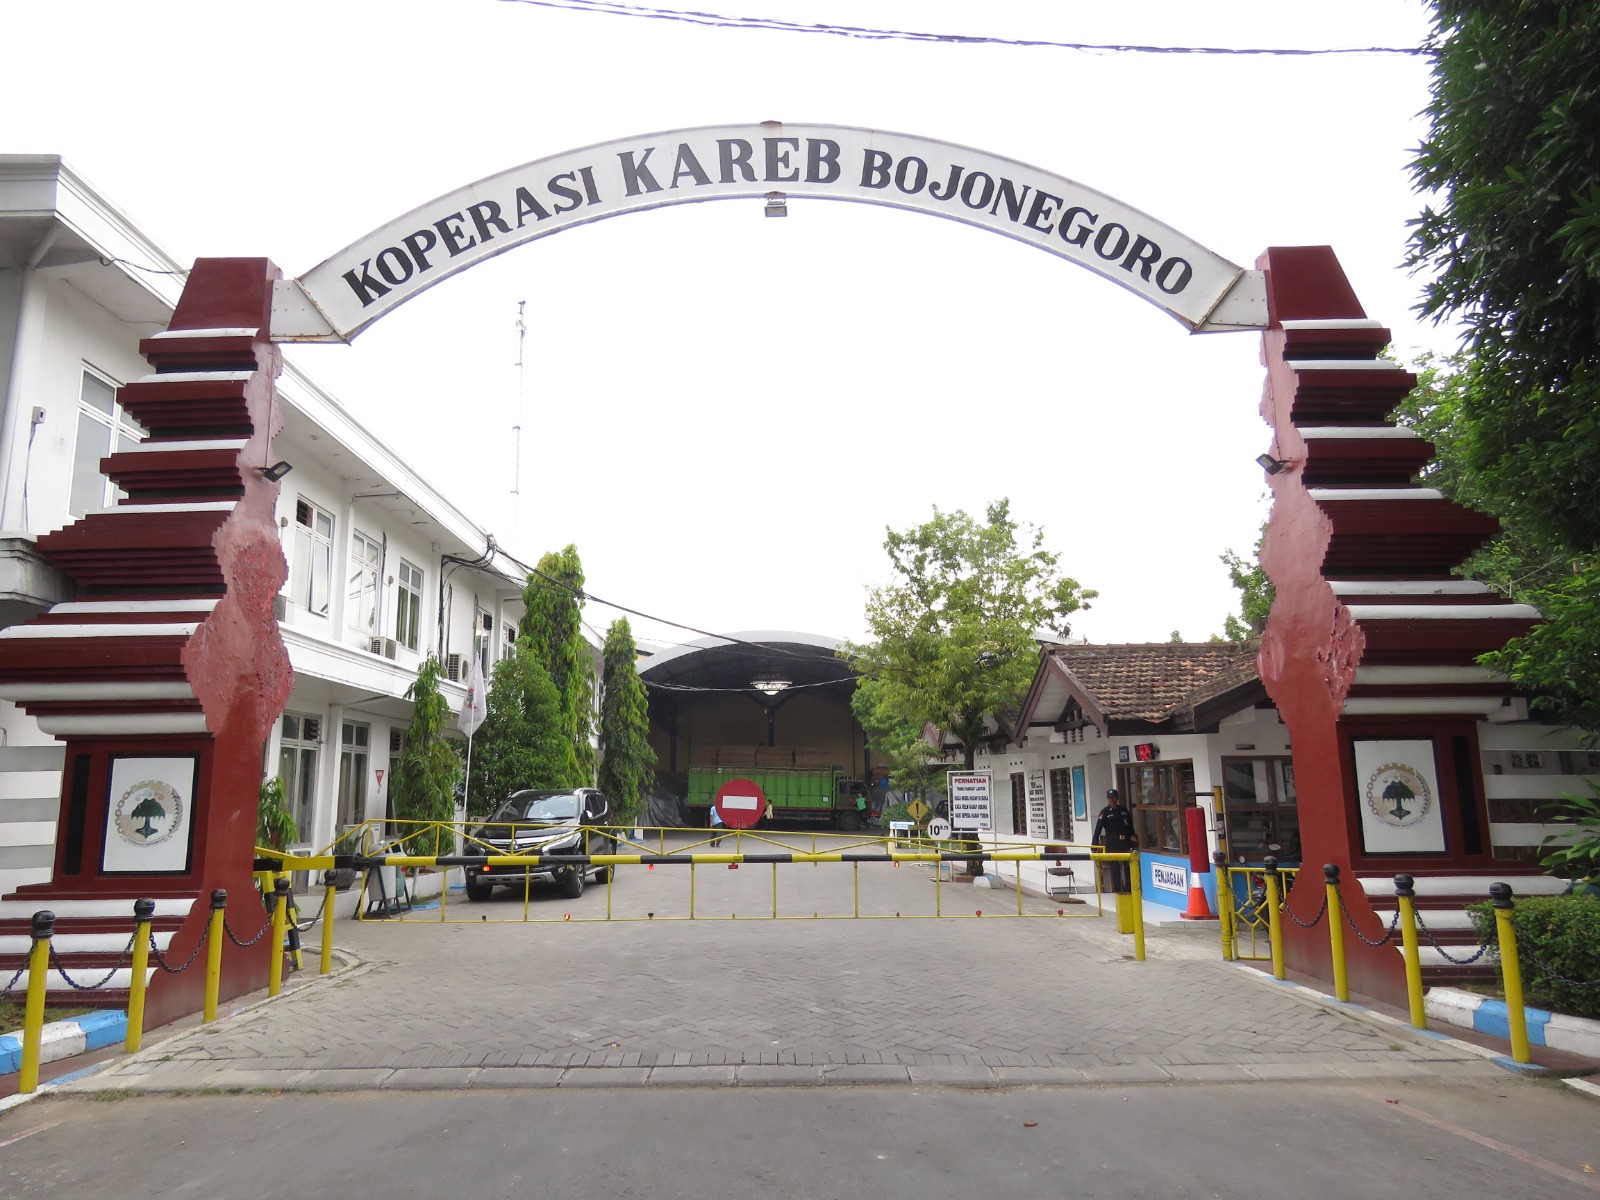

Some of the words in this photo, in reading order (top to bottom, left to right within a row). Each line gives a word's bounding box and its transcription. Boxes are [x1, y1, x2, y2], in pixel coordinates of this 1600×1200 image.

[341, 165, 602, 308] KOPERASI
[617, 137, 841, 198] KAREB
[859, 148, 1193, 295] BOJONEGORO
[930, 825, 940, 835] 10
[1154, 868, 1184, 888] PENJAGAAN
